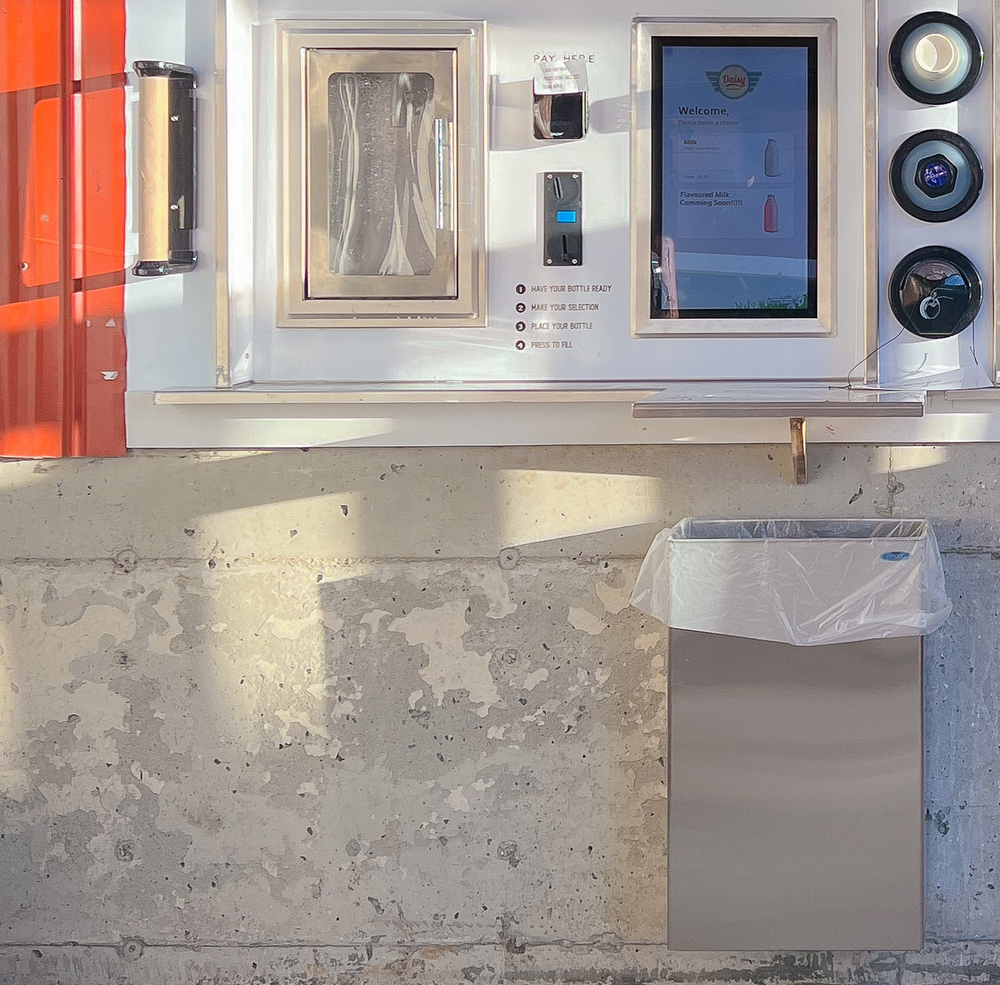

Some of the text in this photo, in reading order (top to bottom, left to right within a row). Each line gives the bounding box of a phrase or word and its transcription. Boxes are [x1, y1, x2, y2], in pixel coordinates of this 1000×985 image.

[534, 54, 556, 63] PAY
[722, 75, 746, 87] Daisy
[678, 106, 729, 116] Welcome,
